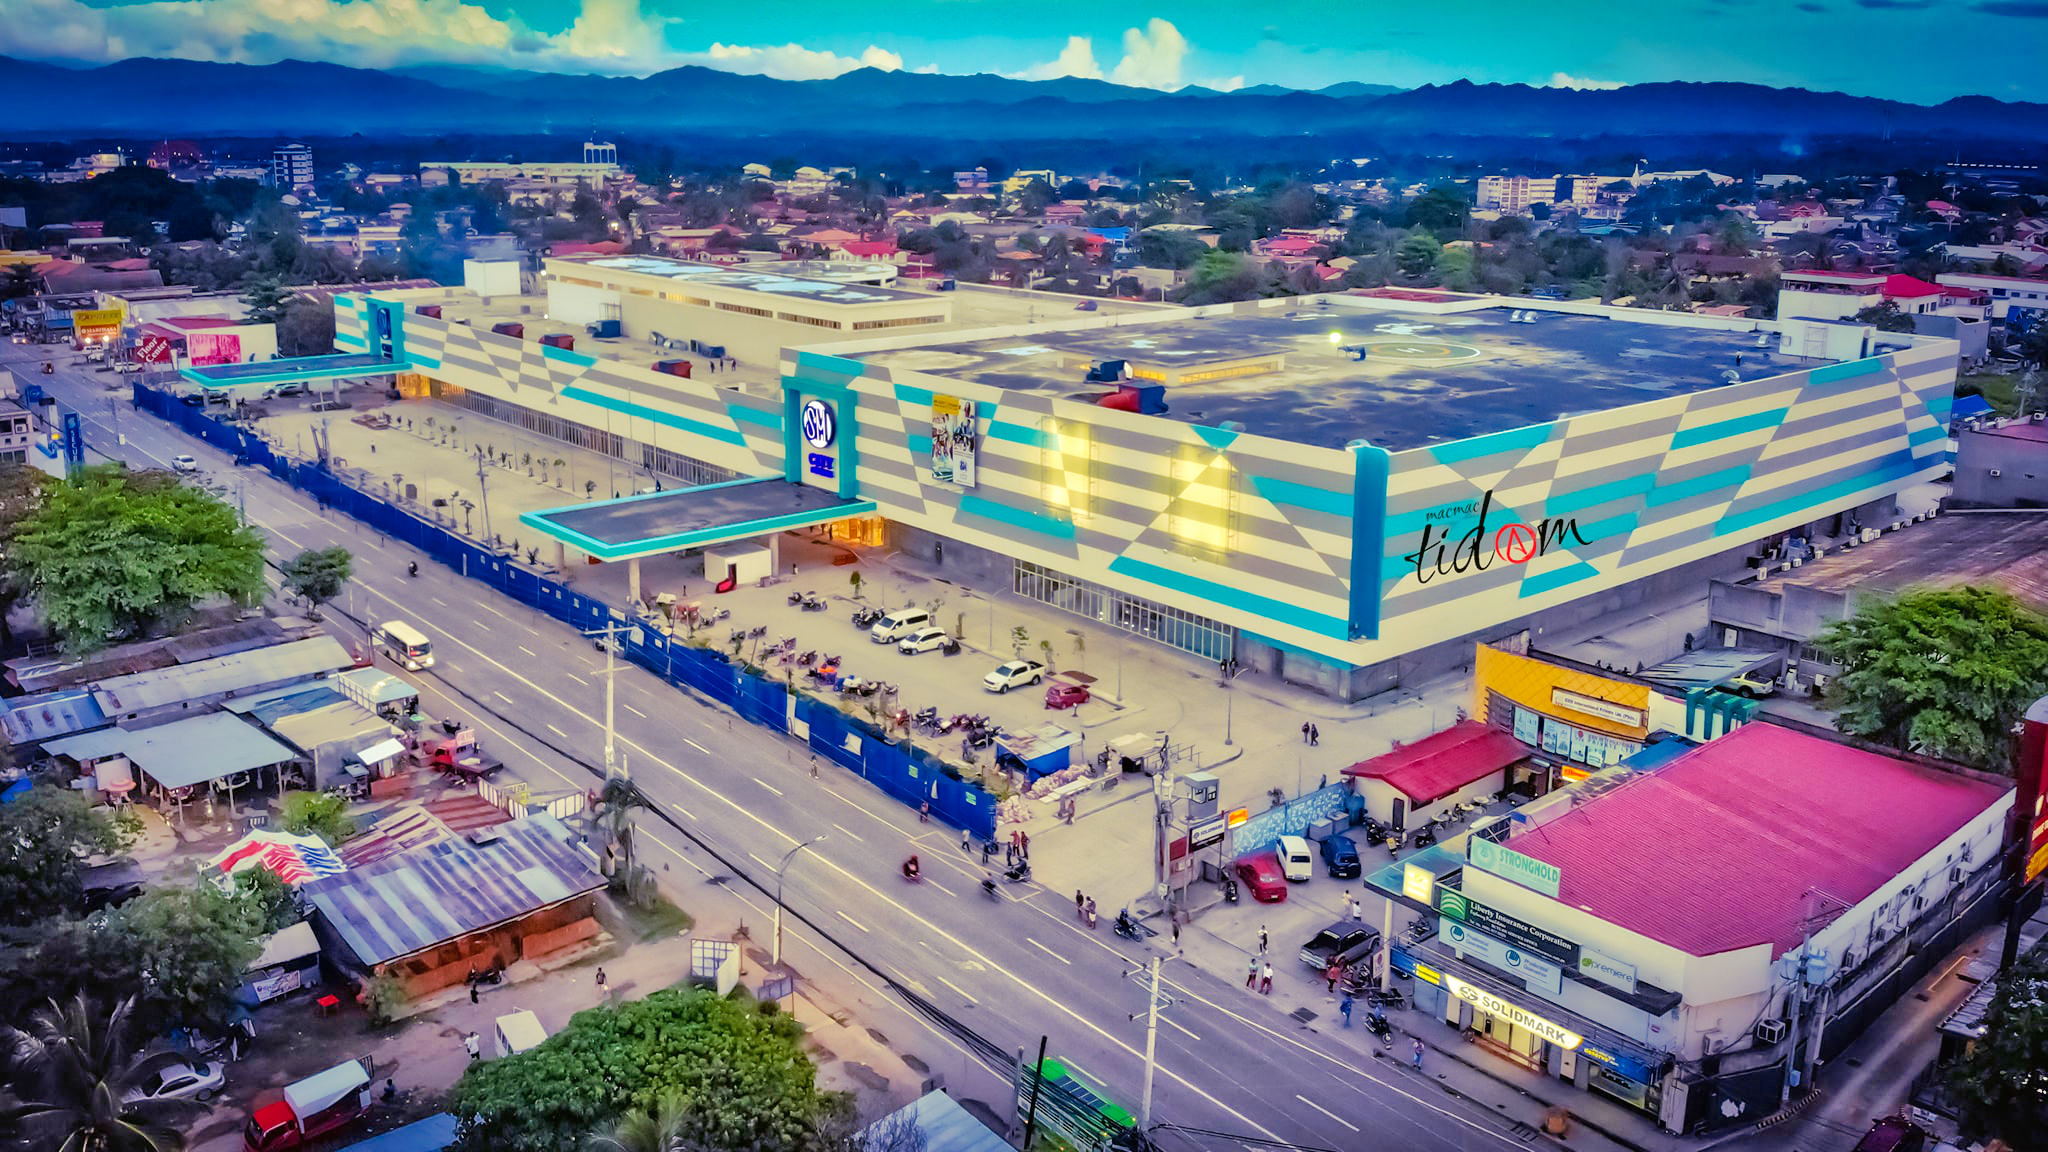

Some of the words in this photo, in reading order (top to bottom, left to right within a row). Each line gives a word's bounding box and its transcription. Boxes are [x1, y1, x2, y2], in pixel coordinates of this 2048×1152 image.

[137, 337, 158, 359] Floor
[145, 340, 168, 363] Center
[804, 404, 830, 444] SM
[1426, 500, 1480, 521] macmac
[1499, 849, 1559, 882] STRONGHOLD
[1470, 901, 1494, 919] Liberty
[1495, 912, 1529, 932] Insurance
[1530, 927, 1572, 950] Corporation
[1482, 995, 1566, 1044] SOLIDMARK
